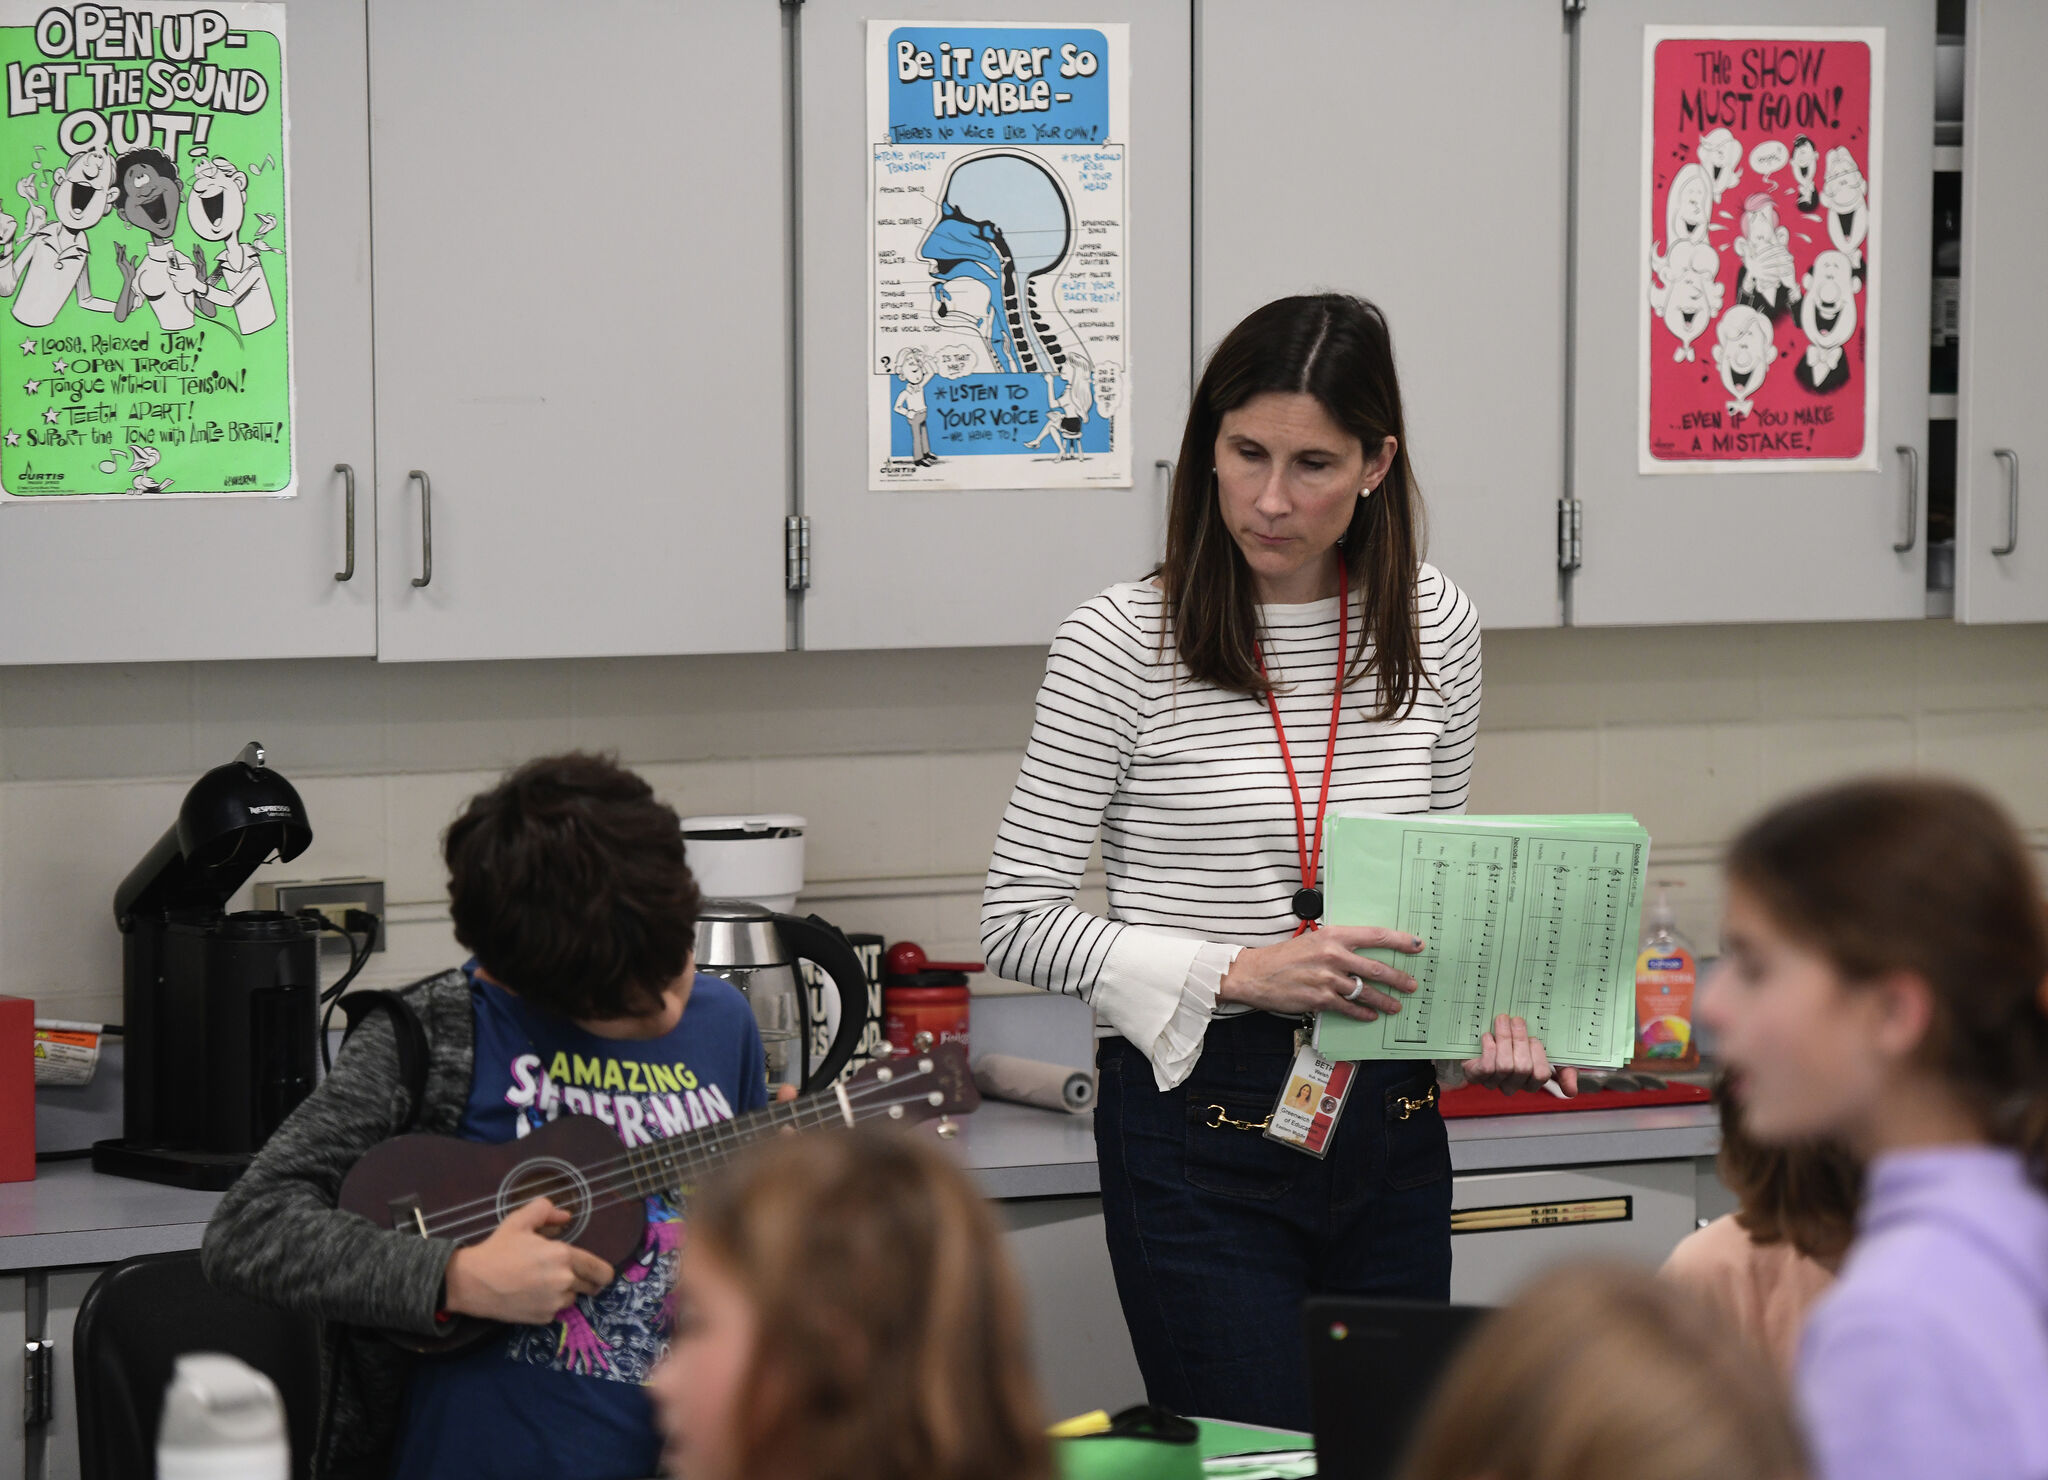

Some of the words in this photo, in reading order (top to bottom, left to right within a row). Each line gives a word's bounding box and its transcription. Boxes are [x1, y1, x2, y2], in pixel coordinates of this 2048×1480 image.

[35, 3, 154, 60] OPEN
[161, 9, 247, 63] UP-
[897, 40, 935, 83] Be
[980, 46, 1051, 82] ever
[1742, 47, 1824, 89] SHOW
[84, 63, 143, 110] THE
[146, 58, 268, 115] SOUND
[1679, 88, 1752, 132] MUST
[1759, 91, 1790, 133] GO
[1796, 85, 1843, 129] ON!
[58, 108, 214, 165] OUT!
[160, 331, 205, 354] Jaw!
[1005, 384, 1029, 400] TO
[937, 408, 987, 431] YOUR
[1752, 409, 1788, 427] YOU
[1794, 406, 1834, 424] MAKE
[1692, 435, 1702, 451] A
[1713, 429, 1815, 452] MISTAKE!
[550, 1051, 698, 1093] AMAZING
